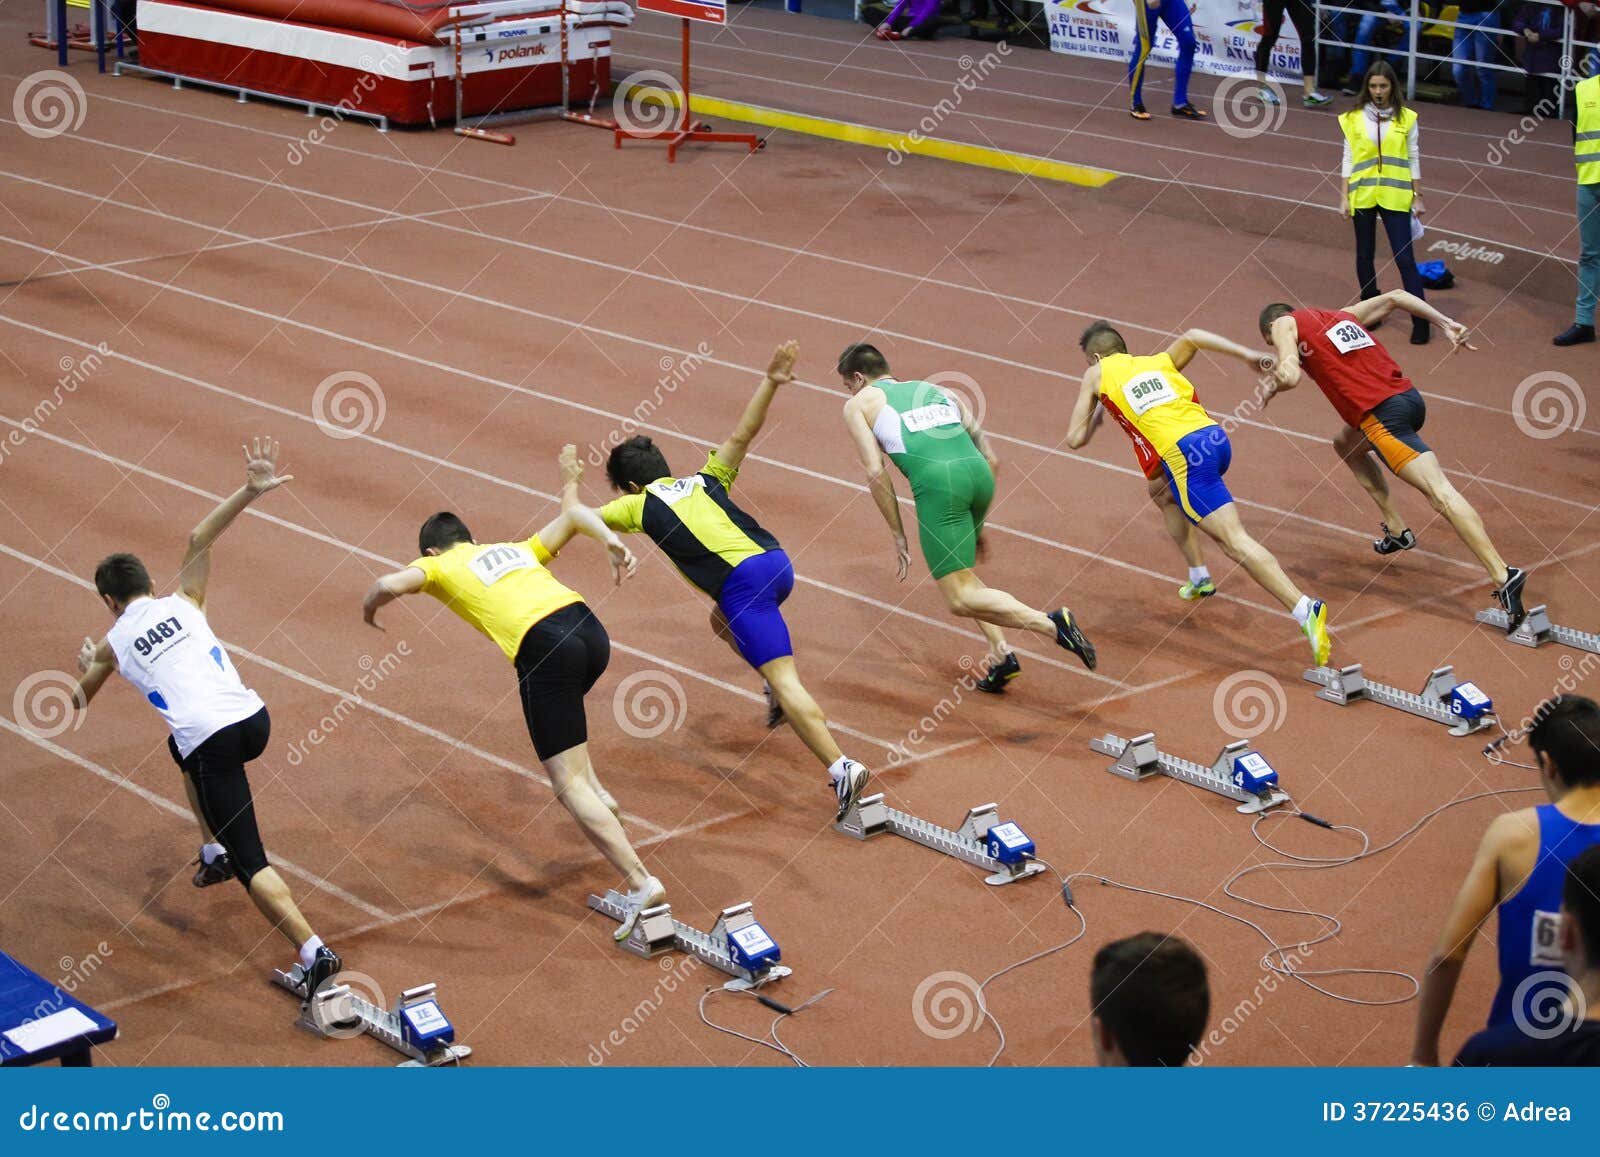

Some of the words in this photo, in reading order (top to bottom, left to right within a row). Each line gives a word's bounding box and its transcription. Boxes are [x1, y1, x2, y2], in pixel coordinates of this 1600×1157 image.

[1052, 23, 1120, 44] ATLETISM
[1232, 36, 1246, 47] EU
[498, 42, 546, 63] polanik
[1427, 240, 1505, 265] polytan
[1131, 378, 1163, 399] 5816
[134, 616, 183, 656] 9487
[1452, 699, 1462, 714] 5
[1235, 771, 1244, 787] 4
[991, 841, 1000, 858] 3
[730, 945, 740, 964] 2
